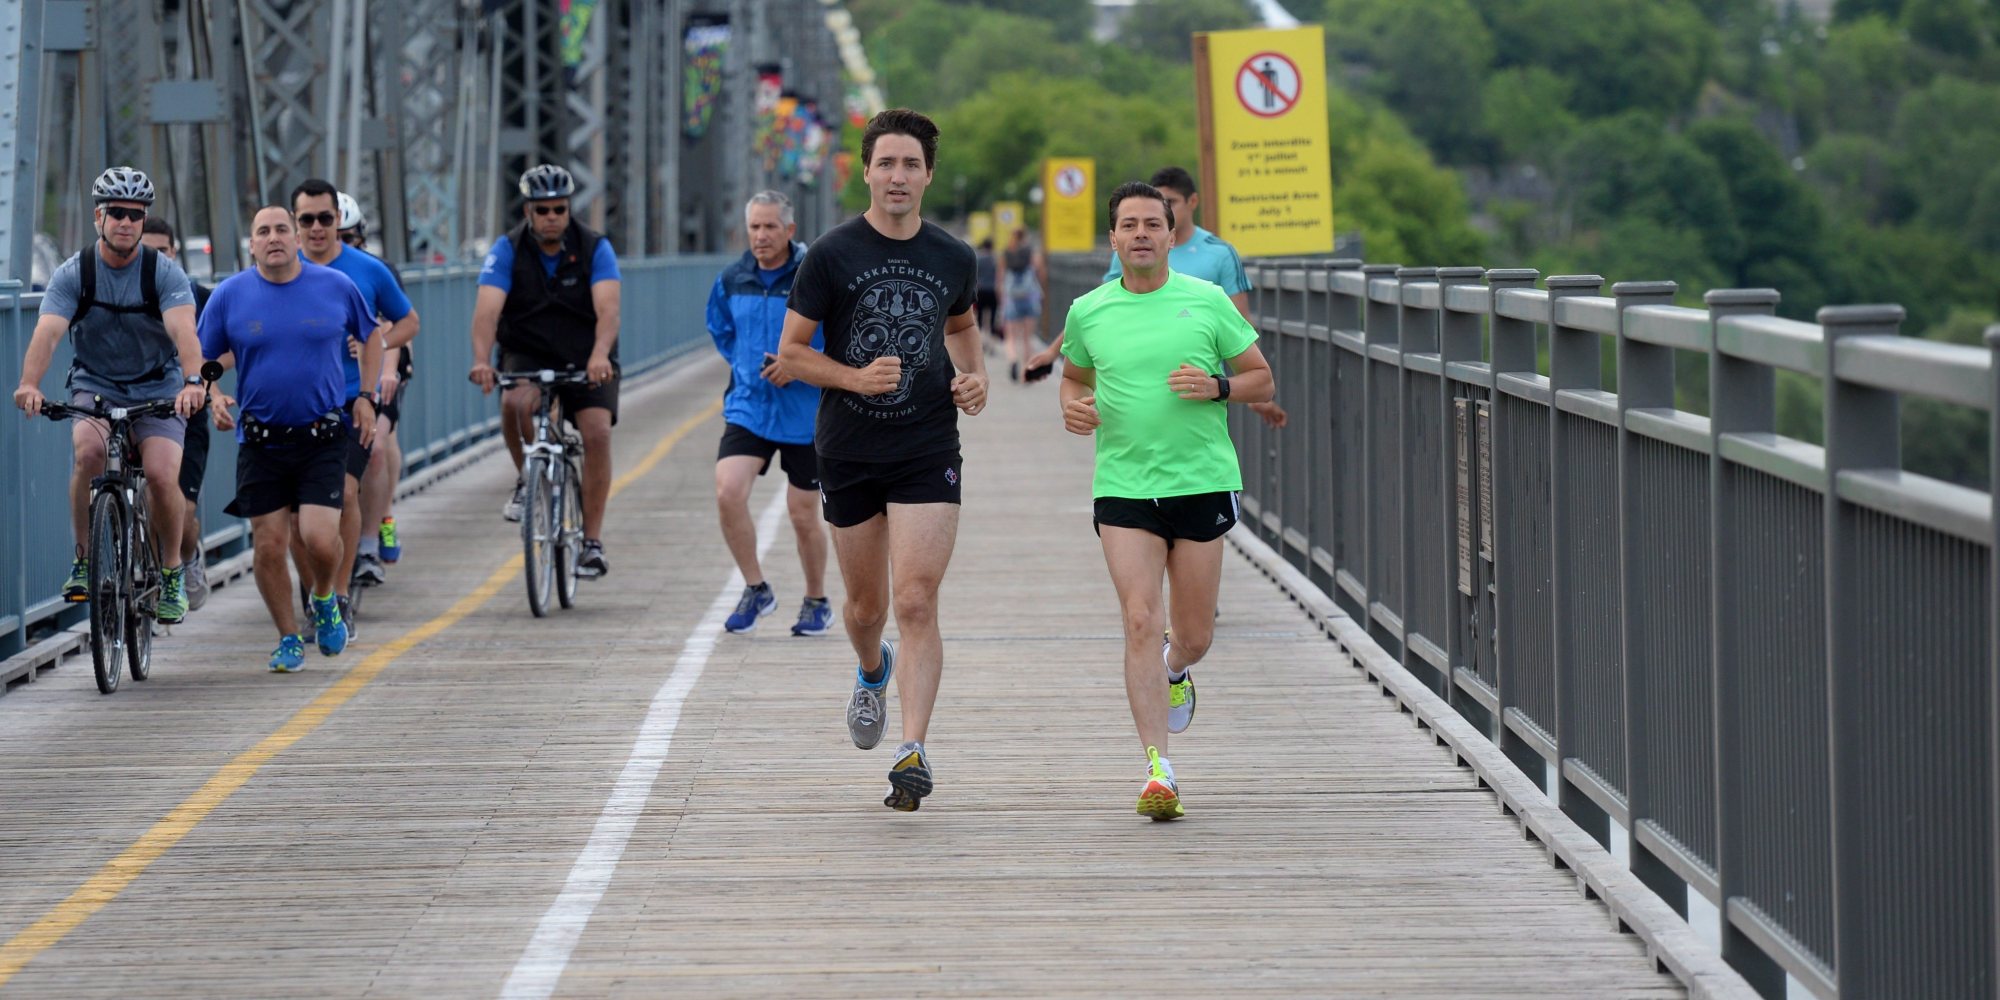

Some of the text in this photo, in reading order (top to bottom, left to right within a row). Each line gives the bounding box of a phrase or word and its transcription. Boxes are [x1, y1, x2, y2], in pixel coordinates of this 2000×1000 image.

[1231, 138, 1312, 150] Zone interdite
[1230, 192, 1319, 203] Restricted Area
[848, 265, 949, 296] SASKATCHEWAN
[843, 397, 917, 419] JAZZ FESTIVAL
